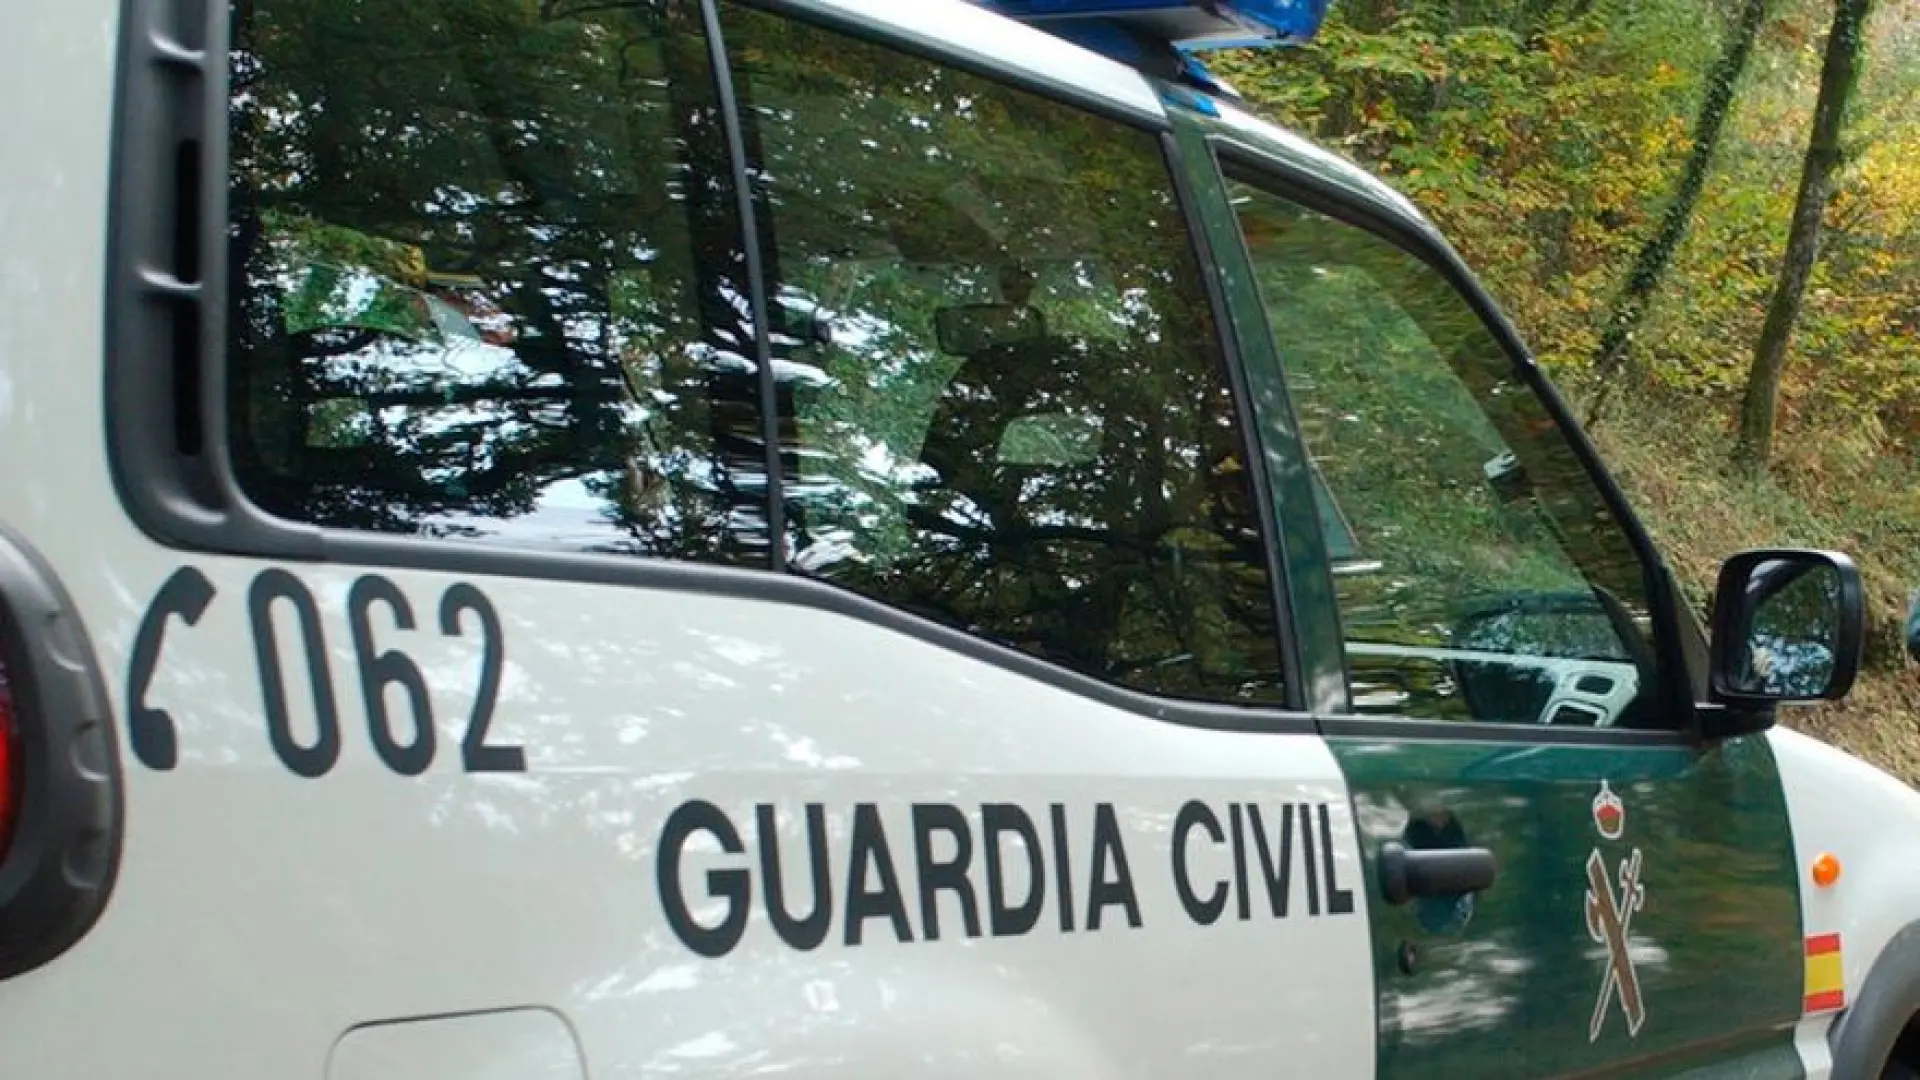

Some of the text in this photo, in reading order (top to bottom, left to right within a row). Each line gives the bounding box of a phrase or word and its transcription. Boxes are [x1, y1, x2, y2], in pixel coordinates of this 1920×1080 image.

[247, 568, 526, 778] 062
[656, 800, 1355, 958] GUARDIA CIVIL
